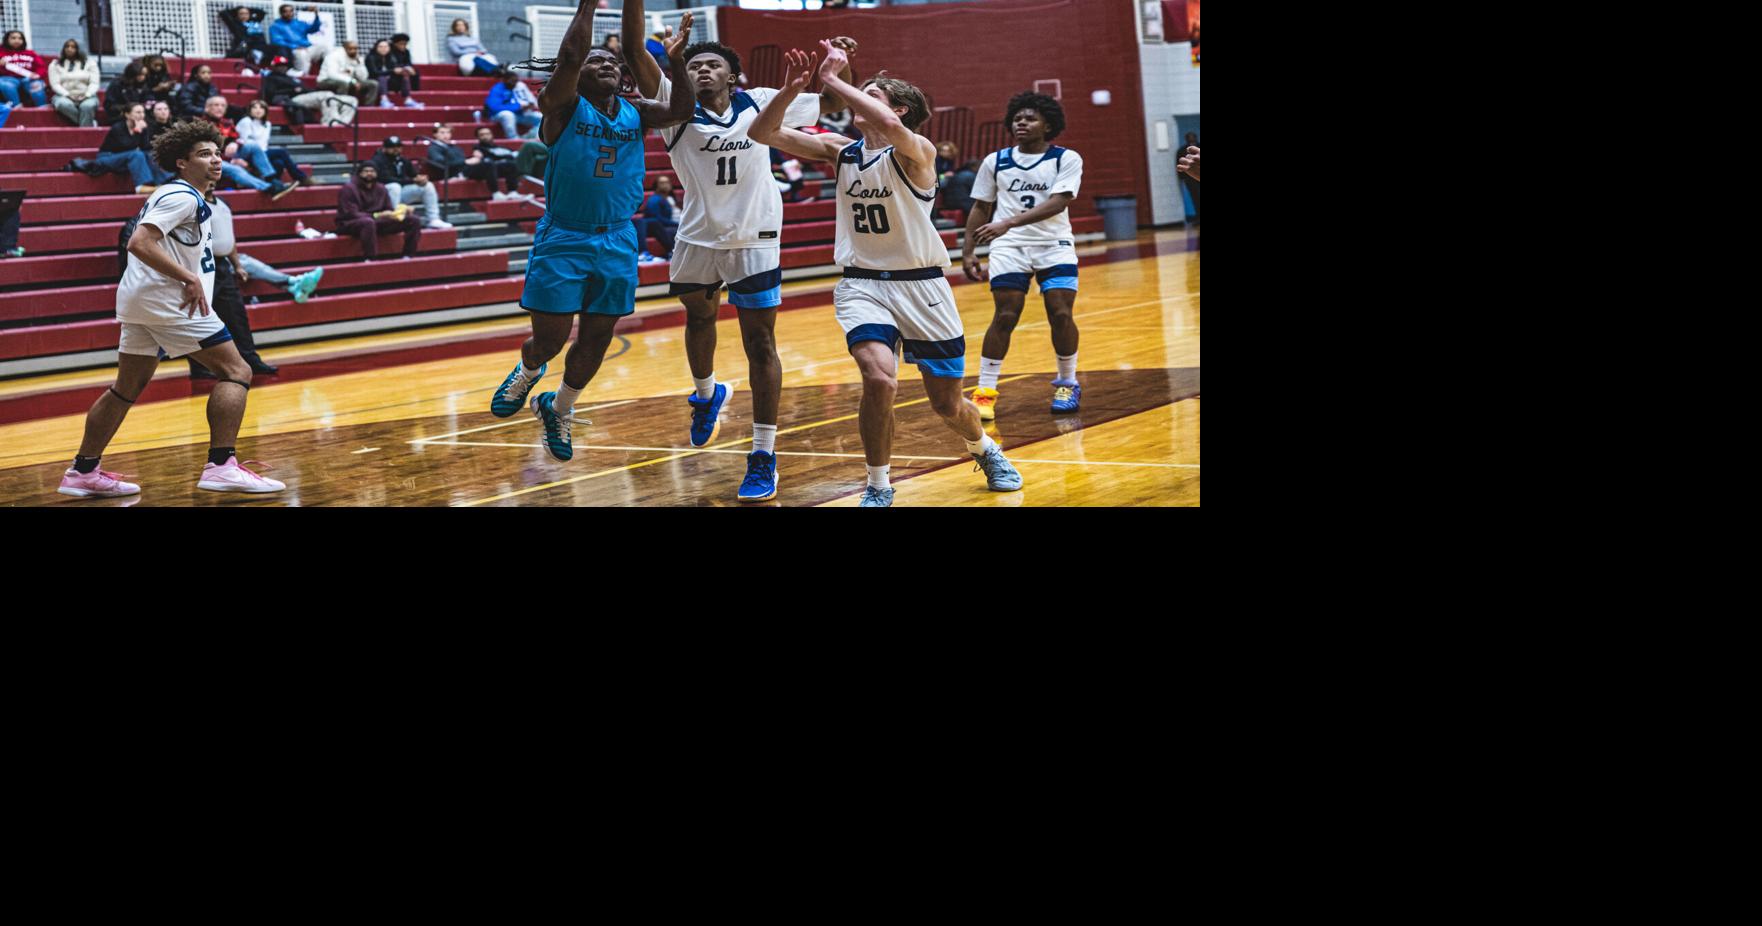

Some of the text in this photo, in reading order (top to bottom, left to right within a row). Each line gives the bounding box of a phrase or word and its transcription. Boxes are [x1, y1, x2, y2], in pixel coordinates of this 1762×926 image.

[700, 135, 752, 152] Lions
[593, 145, 617, 178] 2
[716, 155, 737, 185] 11
[846, 179, 893, 199] Lons
[1008, 178, 1050, 192] Lions
[851, 202, 890, 234] 20
